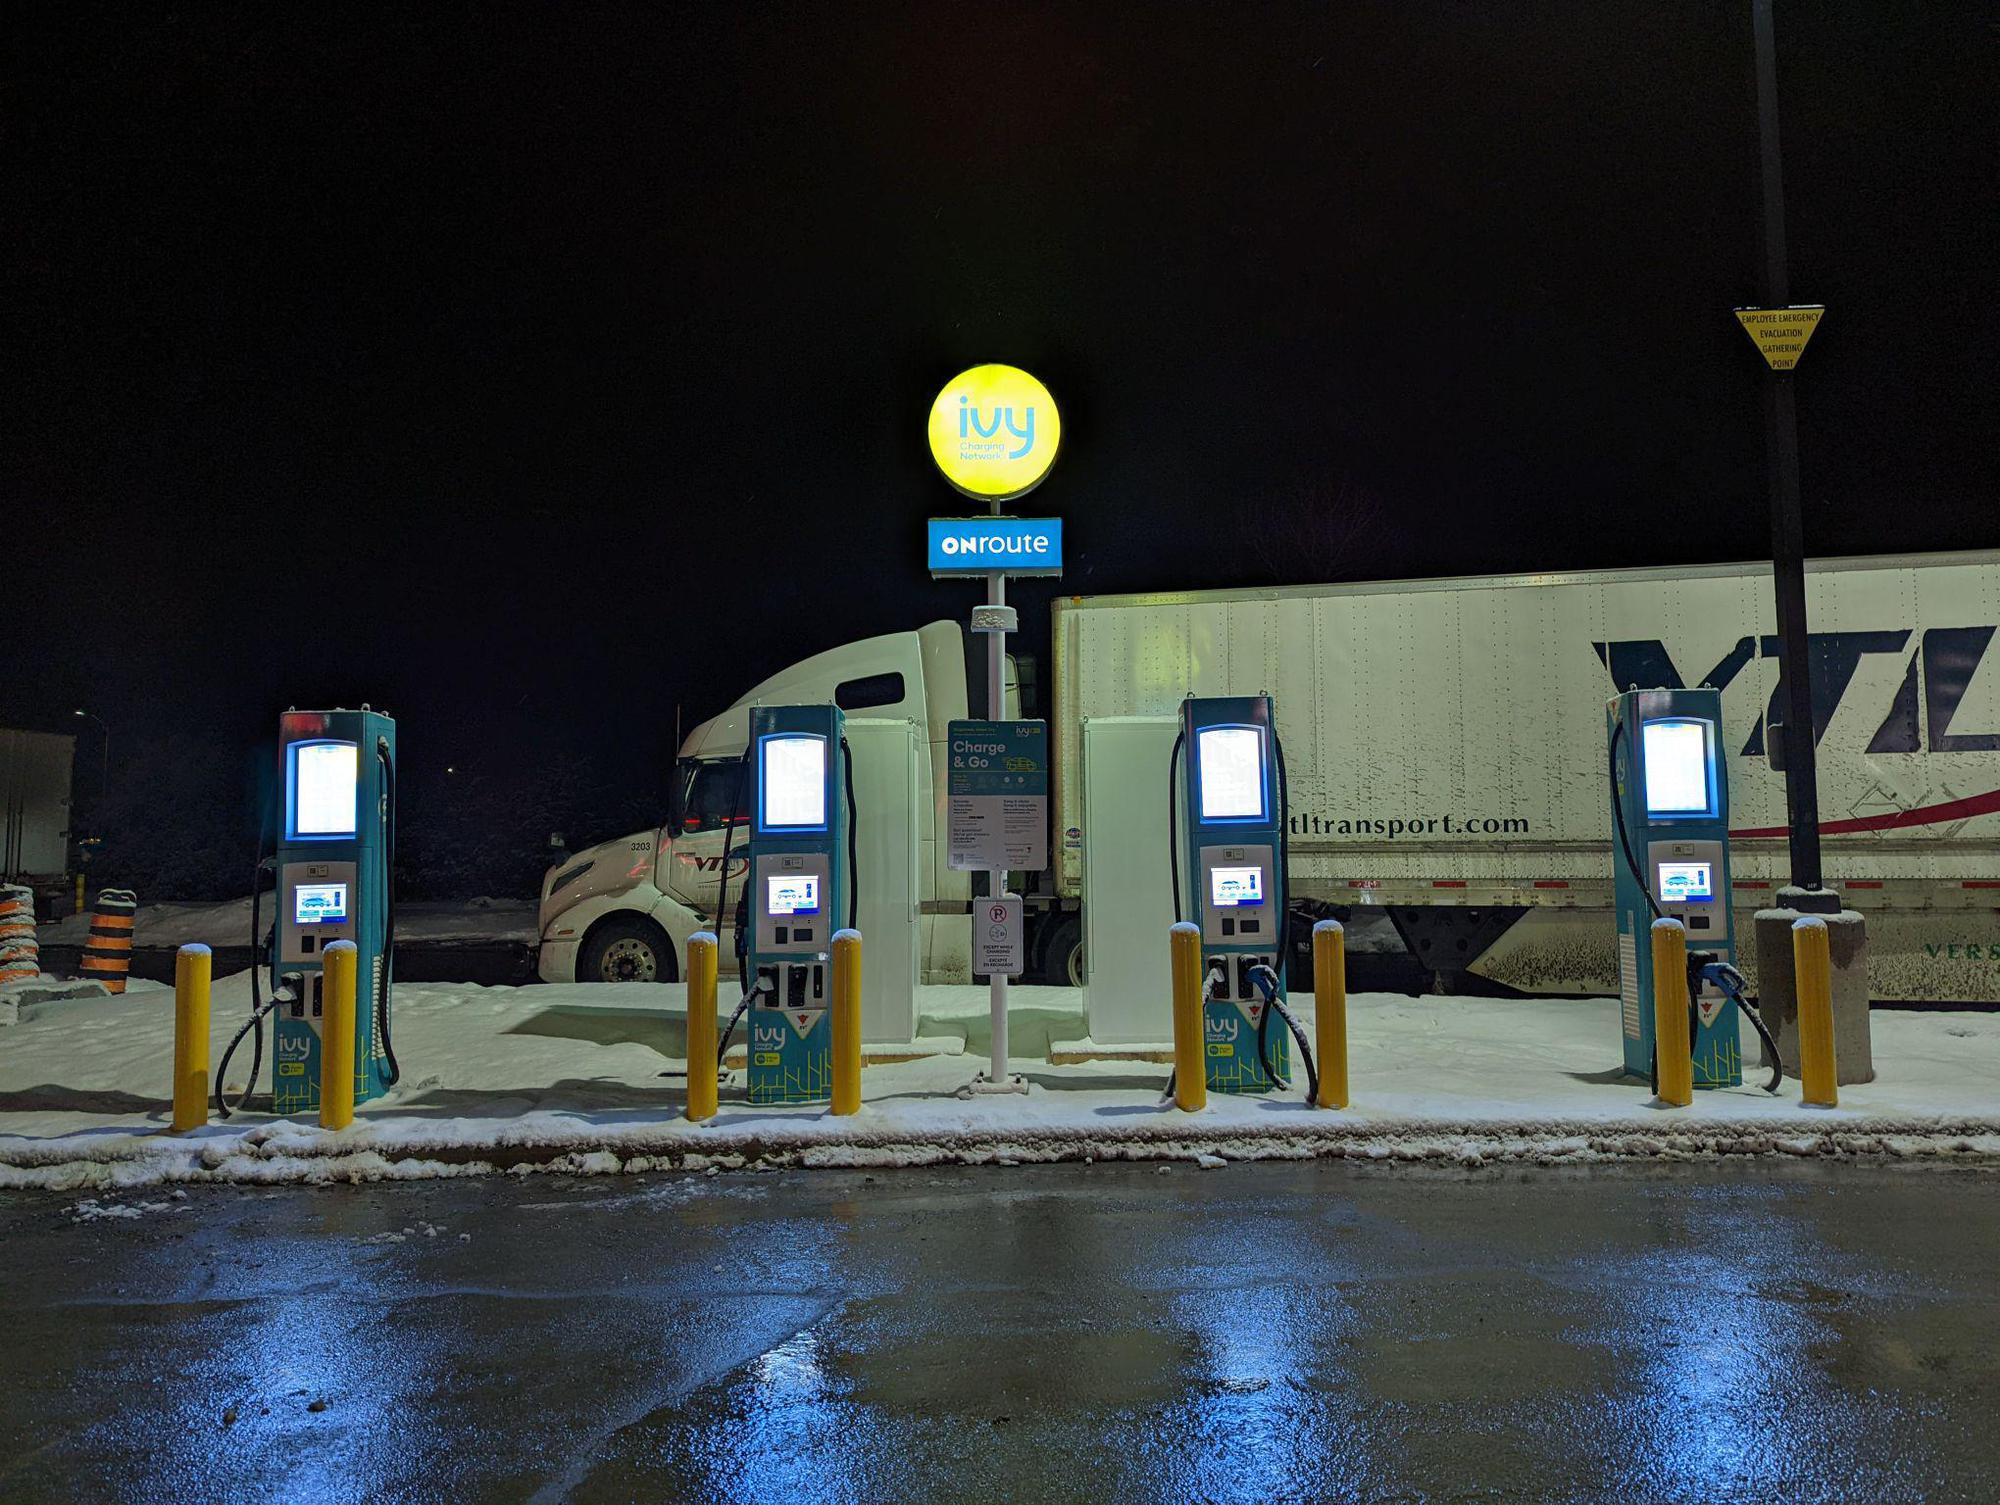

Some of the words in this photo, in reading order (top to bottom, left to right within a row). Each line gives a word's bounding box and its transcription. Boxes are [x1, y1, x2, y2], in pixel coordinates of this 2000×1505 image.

[1742, 314, 1777, 323] EMPLOYEE
[1778, 313, 1819, 322] EMERGENCY
[1760, 329, 1803, 338] EVACUATION
[1762, 344, 1803, 353] GATHERING
[1772, 359, 1794, 368] POINT
[960, 395, 1035, 460] ivy
[960, 442, 1005, 452] Charging
[960, 452, 1001, 460] Network
[941, 535, 1049, 555] ONroute
[1016, 724, 1030, 737] ivy
[953, 740, 1006, 756] Charge
[953, 756, 965, 768] &
[968, 756, 989, 768] Go
[1290, 813, 1530, 838] tltransport.com
[631, 841, 651, 851] 3203
[1205, 1014, 1238, 1042] ivy
[754, 1023, 786, 1050] ivy
[279, 1032, 311, 1061] ivy
